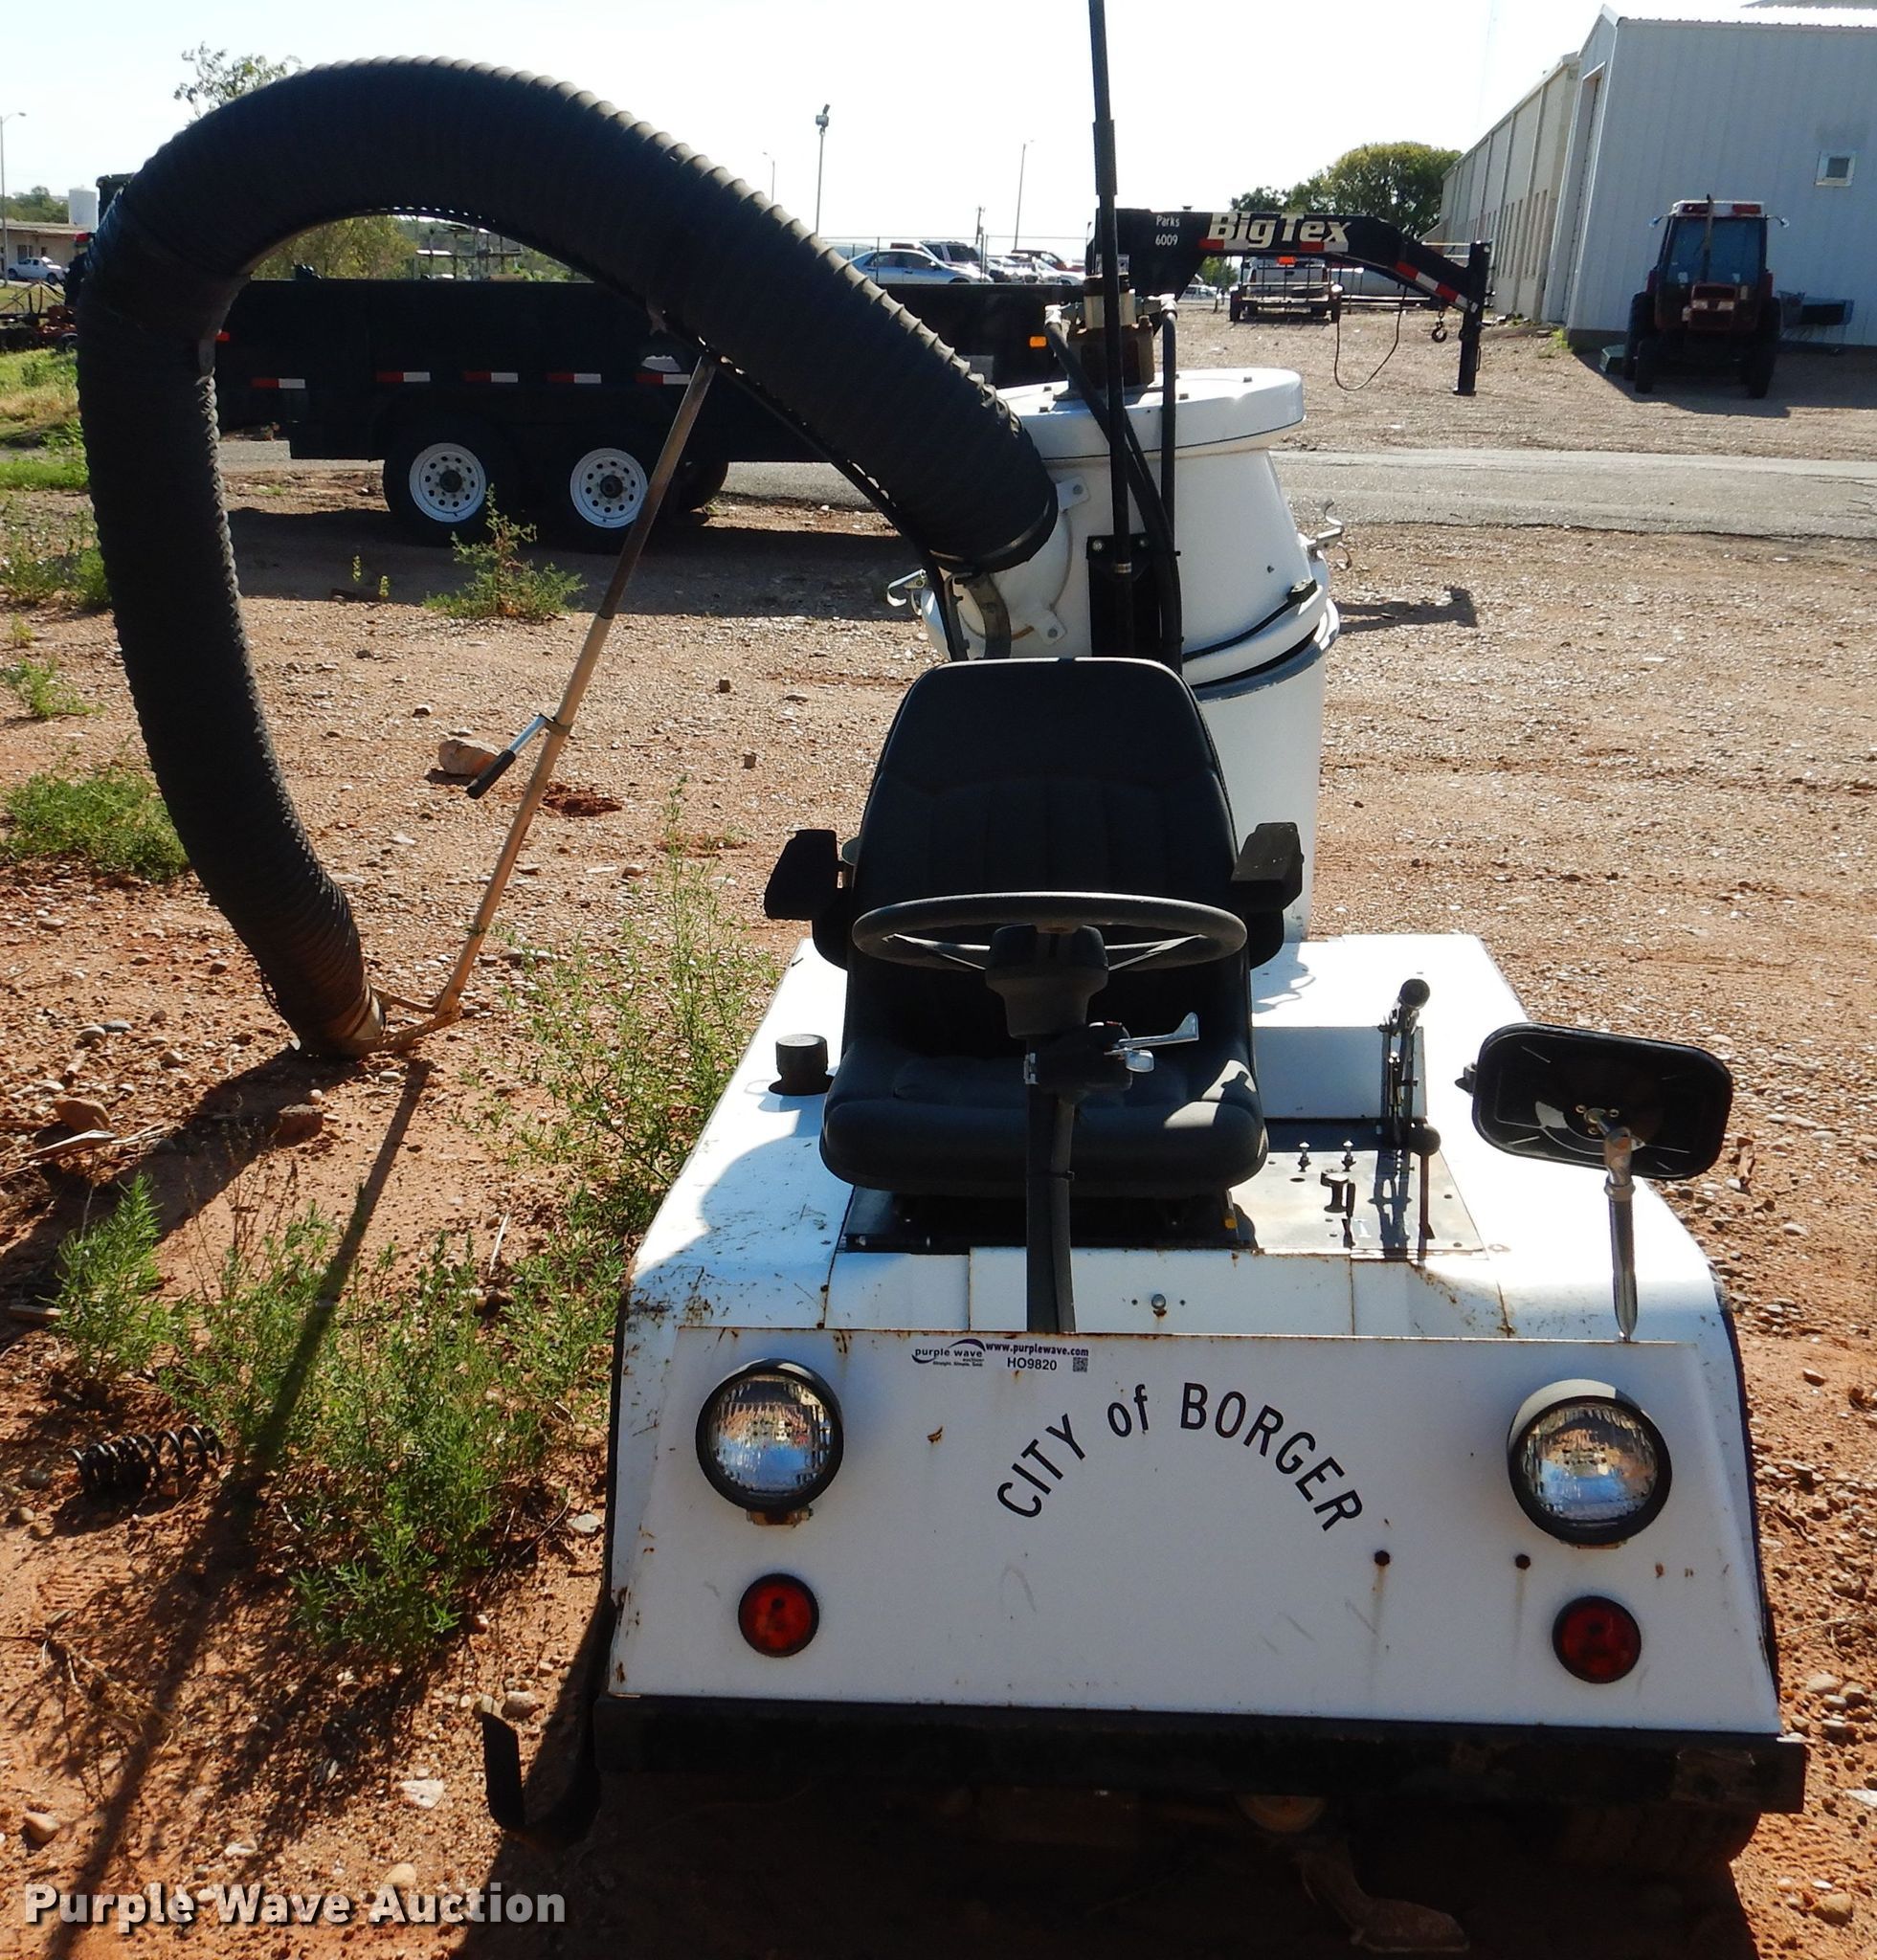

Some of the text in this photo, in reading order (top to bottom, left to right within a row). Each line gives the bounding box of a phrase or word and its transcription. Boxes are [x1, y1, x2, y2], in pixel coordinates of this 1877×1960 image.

[1155, 214, 1180, 228] Parks
[1155, 234, 1178, 246] 6009
[915, 1348, 983, 1358] purple wave
[986, 1343, 1089, 1357] www.purplewave.com
[996, 1382, 1363, 1532] CITY of BORGER
